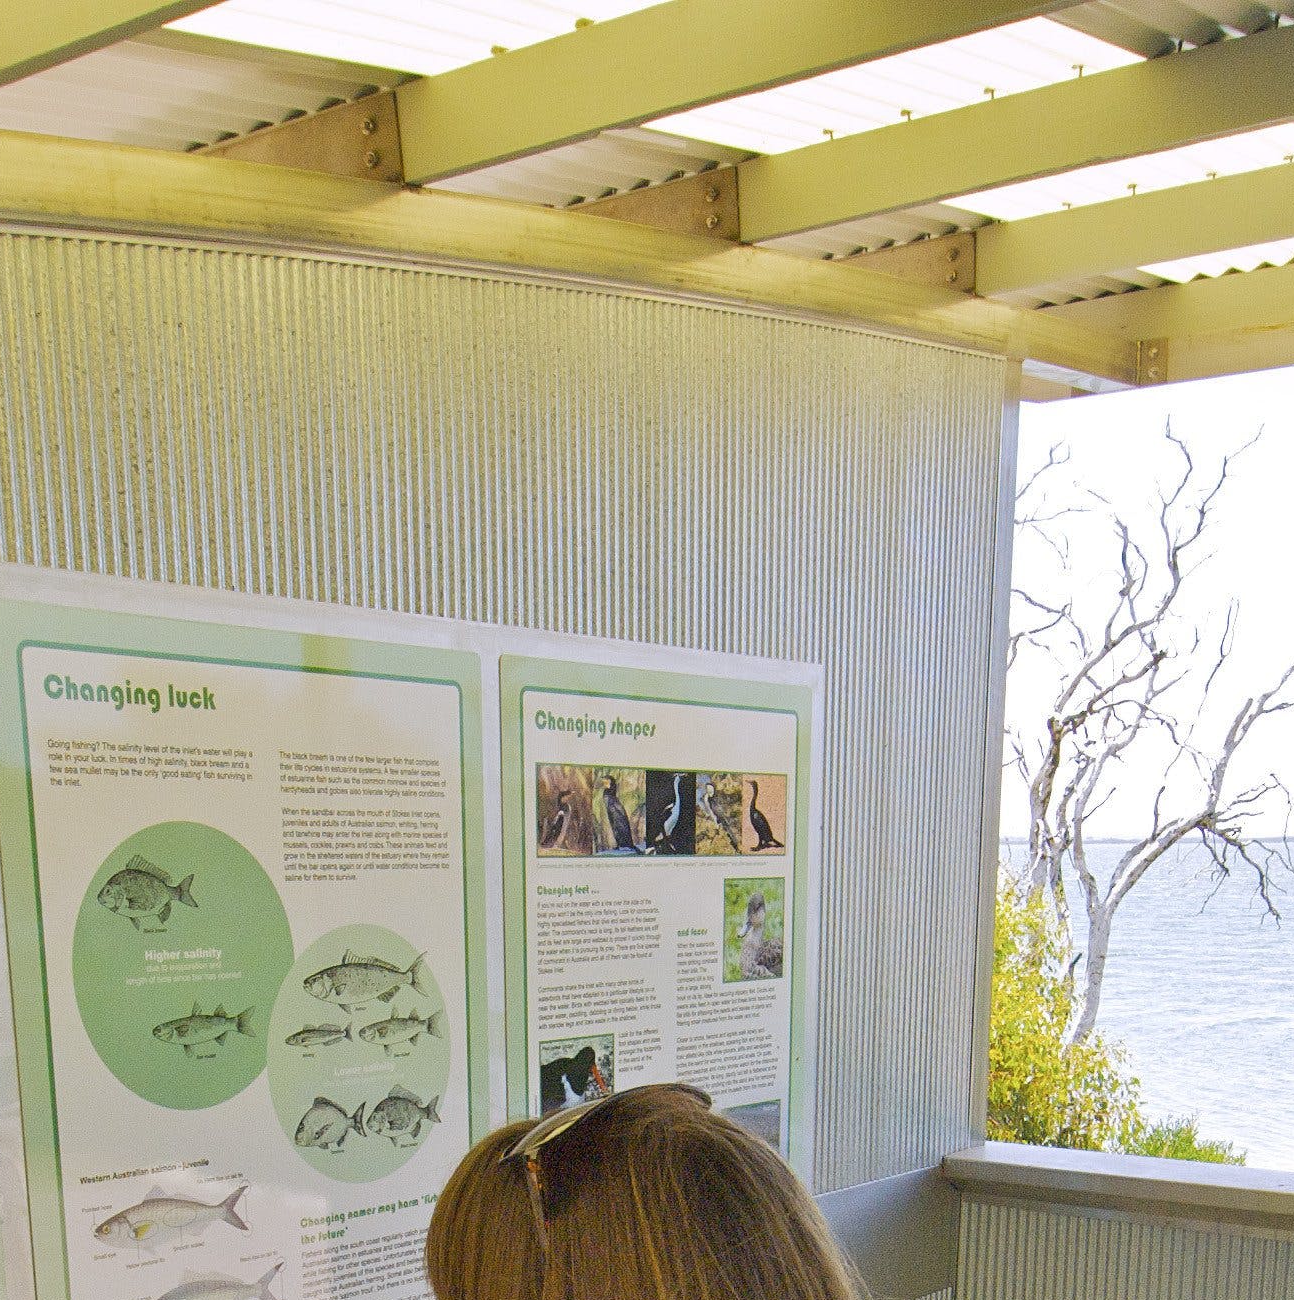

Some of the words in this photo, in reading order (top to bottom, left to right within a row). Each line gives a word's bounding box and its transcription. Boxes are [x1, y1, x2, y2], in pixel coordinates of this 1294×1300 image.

[43, 674, 161, 713] Changing
[167, 683, 216, 710] luck
[535, 710, 605, 739] Changing
[609, 716, 656, 740] shapes
